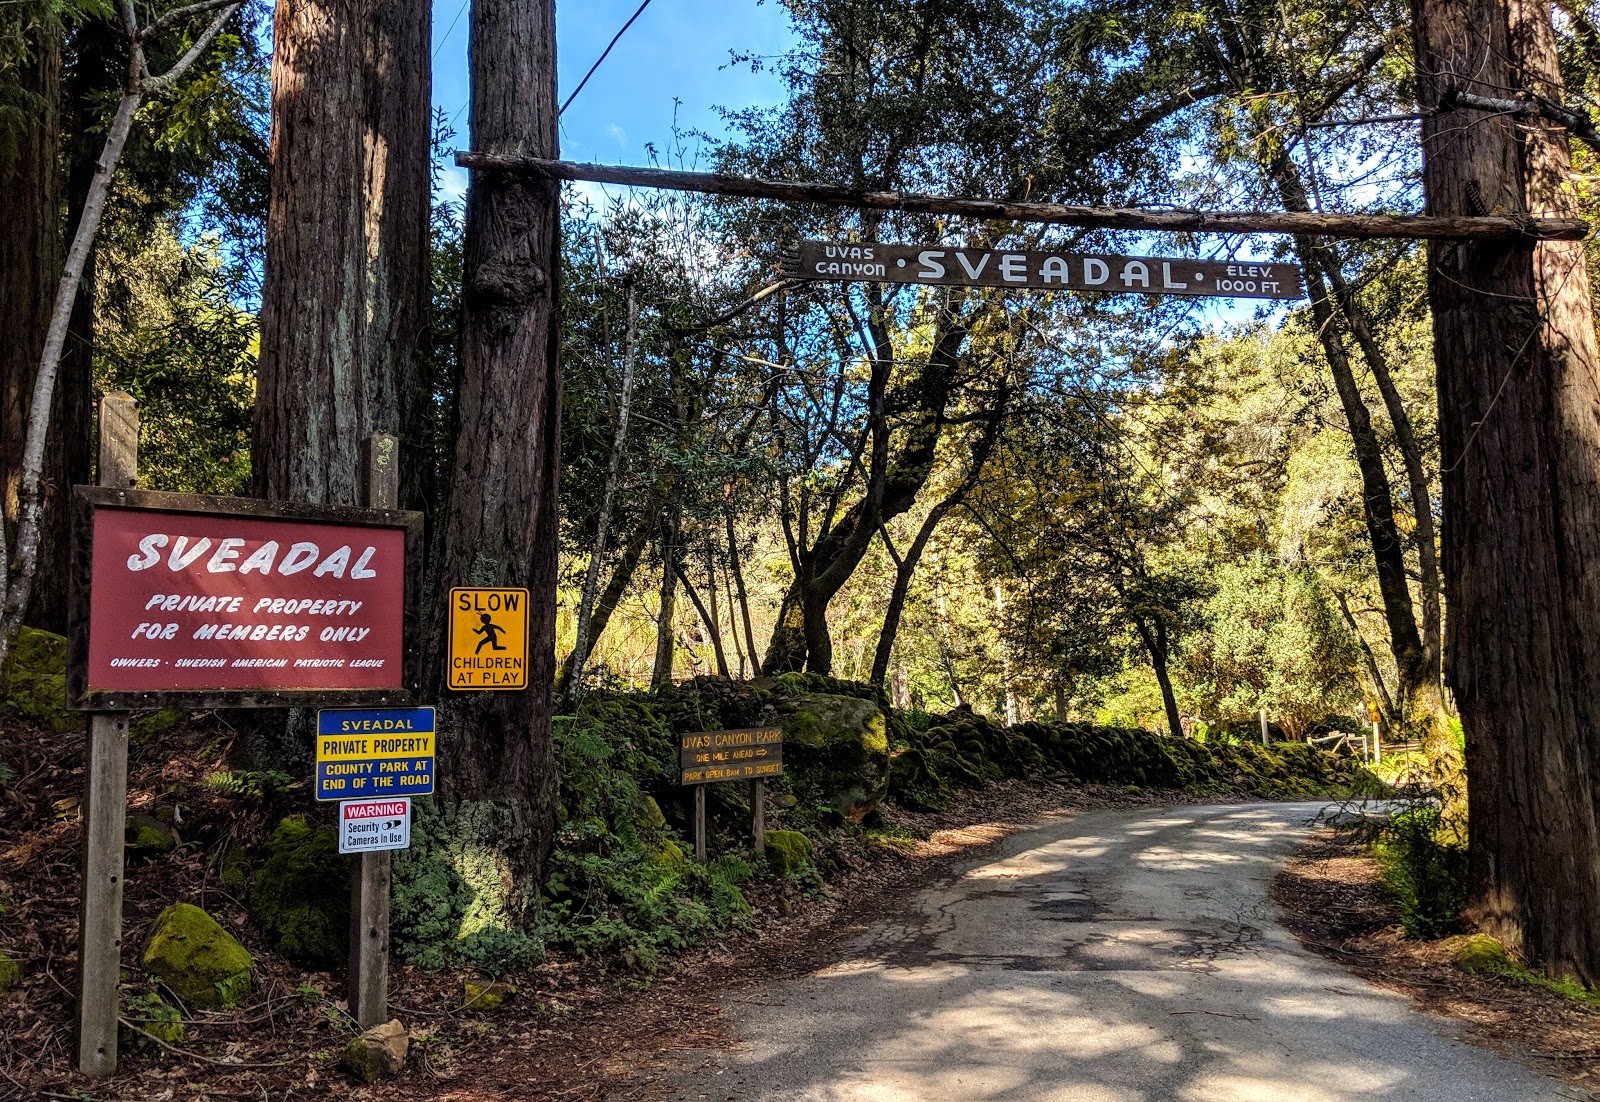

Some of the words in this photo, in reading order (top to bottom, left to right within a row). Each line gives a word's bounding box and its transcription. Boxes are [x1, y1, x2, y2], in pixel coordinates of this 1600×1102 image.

[825, 246, 874, 260] UVAS
[815, 261, 886, 276] CANYON
[918, 251, 1187, 290] SVEADAL
[1226, 265, 1273, 278] ELEV.
[1216, 279, 1256, 292] 1000
[1261, 282, 1281, 294] FT.
[126, 534, 376, 579] SVEADAL
[145, 594, 243, 613] PRIVATE
[253, 598, 363, 616] PROPERTY
[458, 593, 519, 612] SLOW
[131, 623, 179, 640] FOR
[192, 624, 309, 642] MEMBERS
[320, 626, 370, 642] ONLY
[110, 658, 159, 668] OWNERS
[174, 658, 226, 668] SWEDISH
[231, 658, 288, 668] AMERICAN
[293, 658, 344, 668] PATRIOTIC
[350, 658, 384, 668] LEAGUE
[454, 657, 522, 668] CHILDREN
[456, 672, 474, 684] AT
[482, 672, 519, 684] PLAY
[342, 719, 413, 731] SVEADAL
[323, 740, 368, 755] PRIVATE
[374, 738, 429, 754] PROPERTY
[682, 736, 710, 748] UVAS
[715, 732, 752, 746] CANYON
[756, 730, 780, 743] PARK
[696, 753, 710, 762] ONE
[712, 752, 729, 760] MILE
[733, 750, 754, 758] AHEAD
[326, 763, 373, 776] COUNTY
[380, 762, 408, 772] PARK
[414, 760, 428, 771] AT
[684, 772, 702, 781] PARK
[706, 770, 723, 778] OPEN
[744, 766, 752, 775] TO
[756, 764, 780, 774] SUNSET
[322, 779, 346, 790] END
[352, 778, 366, 789] OF
[372, 776, 394, 788] THE
[400, 774, 430, 786] ROAD
[348, 804, 404, 818] WARNING
[348, 822, 380, 833] Security
[348, 836, 378, 846] Cameras
[381, 834, 388, 844] In
[390, 832, 402, 842] Use
